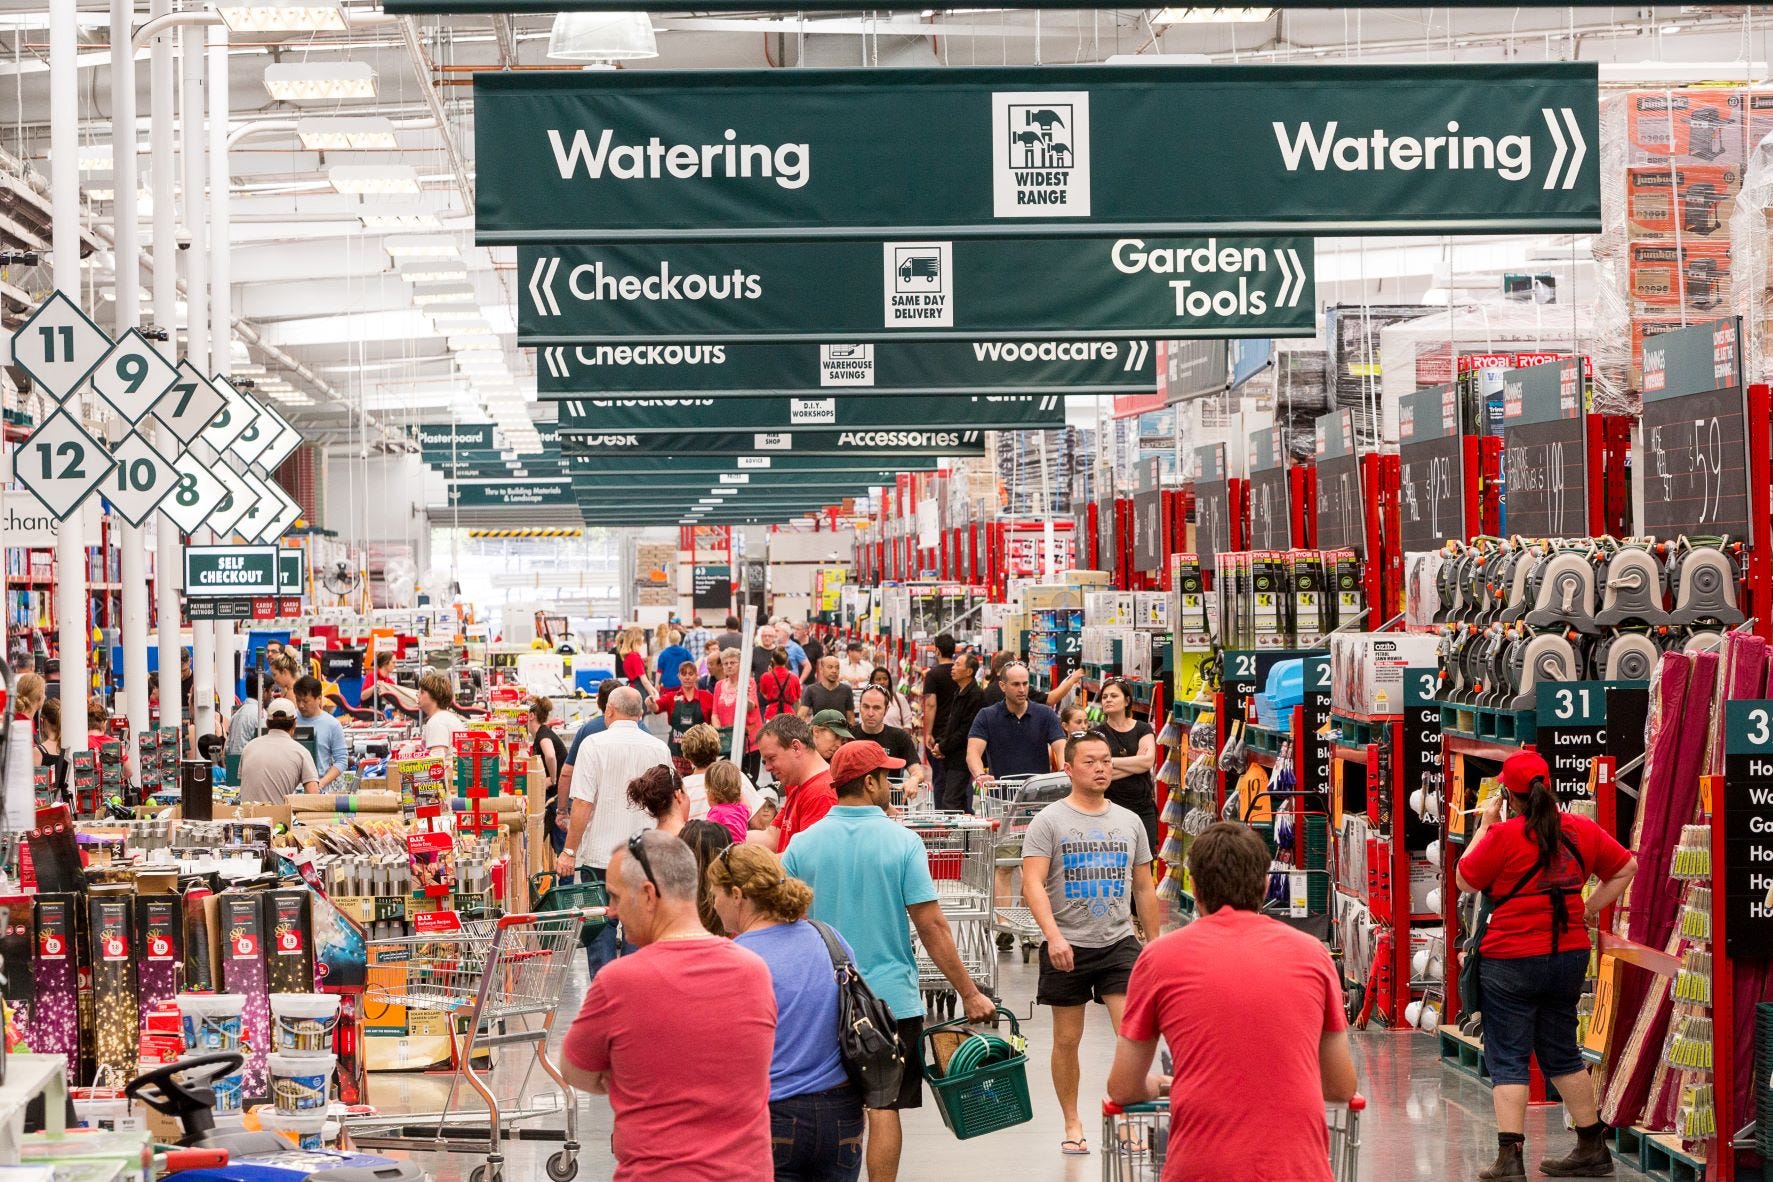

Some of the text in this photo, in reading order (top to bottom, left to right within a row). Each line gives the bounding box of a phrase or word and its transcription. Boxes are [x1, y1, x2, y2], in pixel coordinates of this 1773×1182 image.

[1272, 120, 1532, 181] Watering
[547, 129, 810, 189] Watering
[1014, 172, 1069, 187] WIDEST
[1017, 190, 1068, 205] RANGE
[1111, 238, 1267, 273] Garden
[568, 261, 762, 300] Checkouts
[891, 294, 946, 307] SAME DAY
[1169, 277, 1267, 316] Tools
[894, 308, 944, 320] DELIVERY
[38, 325, 74, 363] 11
[973, 341, 1118, 362] Woodcare
[575, 345, 726, 365] Checkouts
[1474, 356, 1509, 368] RYOBI
[822, 361, 873, 370] WAREHOUSE
[116, 353, 149, 394] 9
[829, 370, 865, 380] SAVINGS
[171, 383, 199, 418] 7
[803, 402, 822, 410] D.I.Y.
[792, 410, 834, 418] WORKSHOPS
[420, 431, 483, 444] Plasterboard
[837, 431, 959, 447] Accessories
[36, 441, 86, 480] 12
[117, 458, 156, 492] 10
[175, 472, 200, 507] 8
[485, 485, 561, 496] Thru to Building Materials
[511, 494, 543, 503] Landscape
[218, 556, 245, 570] SELF
[200, 570, 263, 584] CHECKOUT
[1375, 643, 1395, 651] ozito
[1554, 688, 1590, 719] 31
[1747, 708, 1773, 745] 3
[1554, 731, 1591, 745] Lawn
[1061, 841, 1128, 854] CHICAGO
[1064, 880, 1125, 899] CUTS
